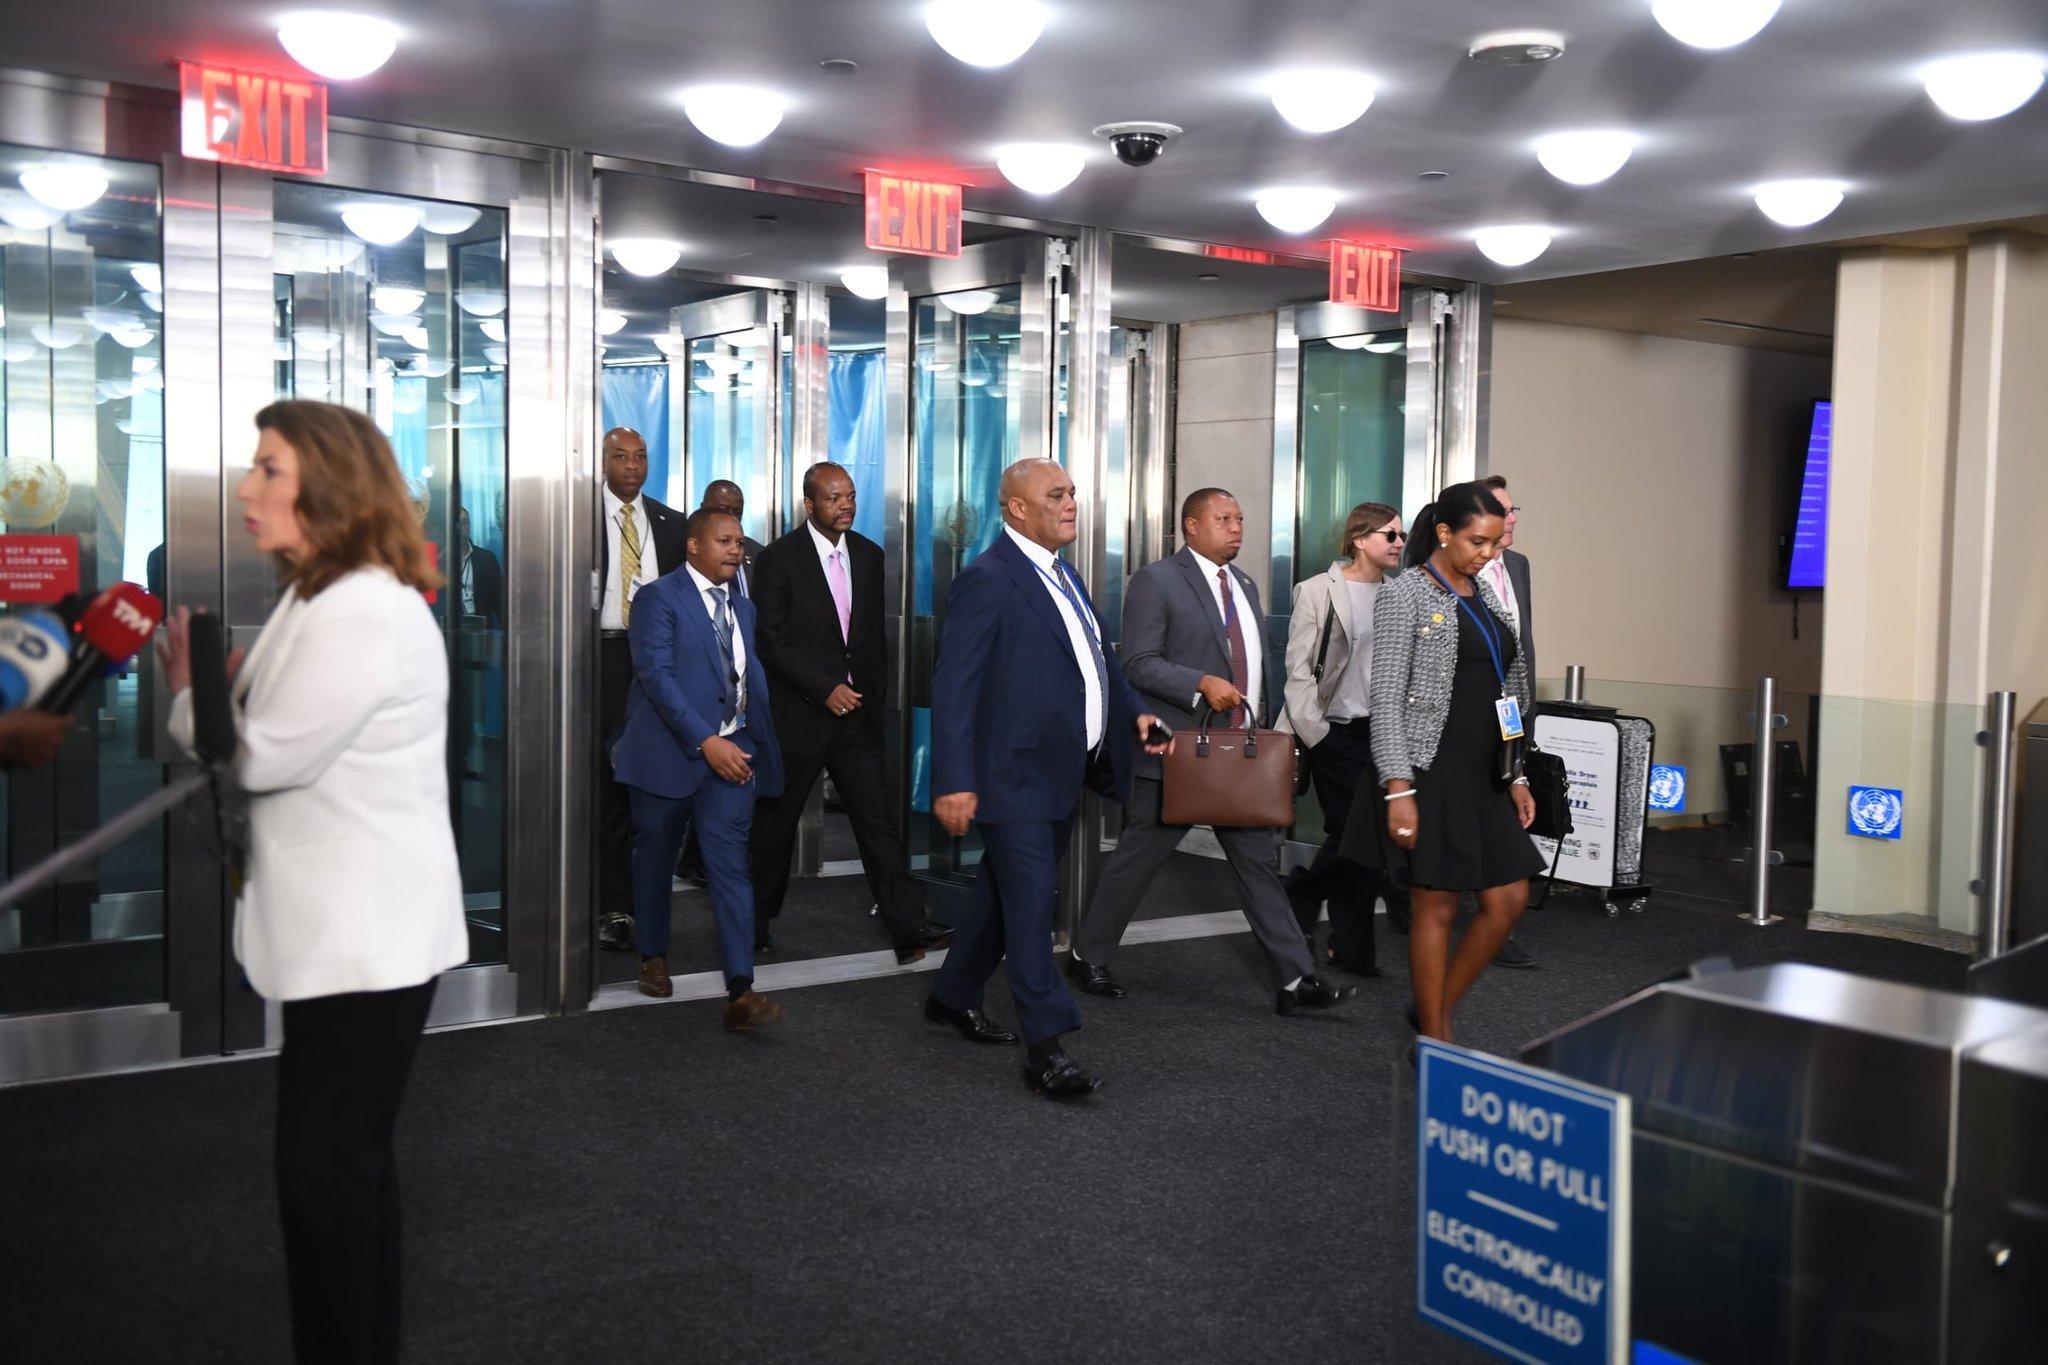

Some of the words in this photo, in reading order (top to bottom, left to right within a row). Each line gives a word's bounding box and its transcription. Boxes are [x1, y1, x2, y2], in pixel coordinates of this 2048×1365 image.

[202, 69, 312, 167] EXIT
[880, 177, 953, 255] EXIT
[1341, 244, 1394, 307] EXIT
[42, 557, 68, 566] OPEN
[1461, 1084, 1504, 1125] DO
[1507, 1099, 1568, 1147] NOT
[1424, 1116, 1491, 1168] PUSH
[1493, 1141, 1536, 1185] OR
[1539, 1156, 1608, 1212] PULL
[1425, 1208, 1605, 1307] ELECTRONICALLY
[1441, 1261, 1585, 1347] CONTROLLED
